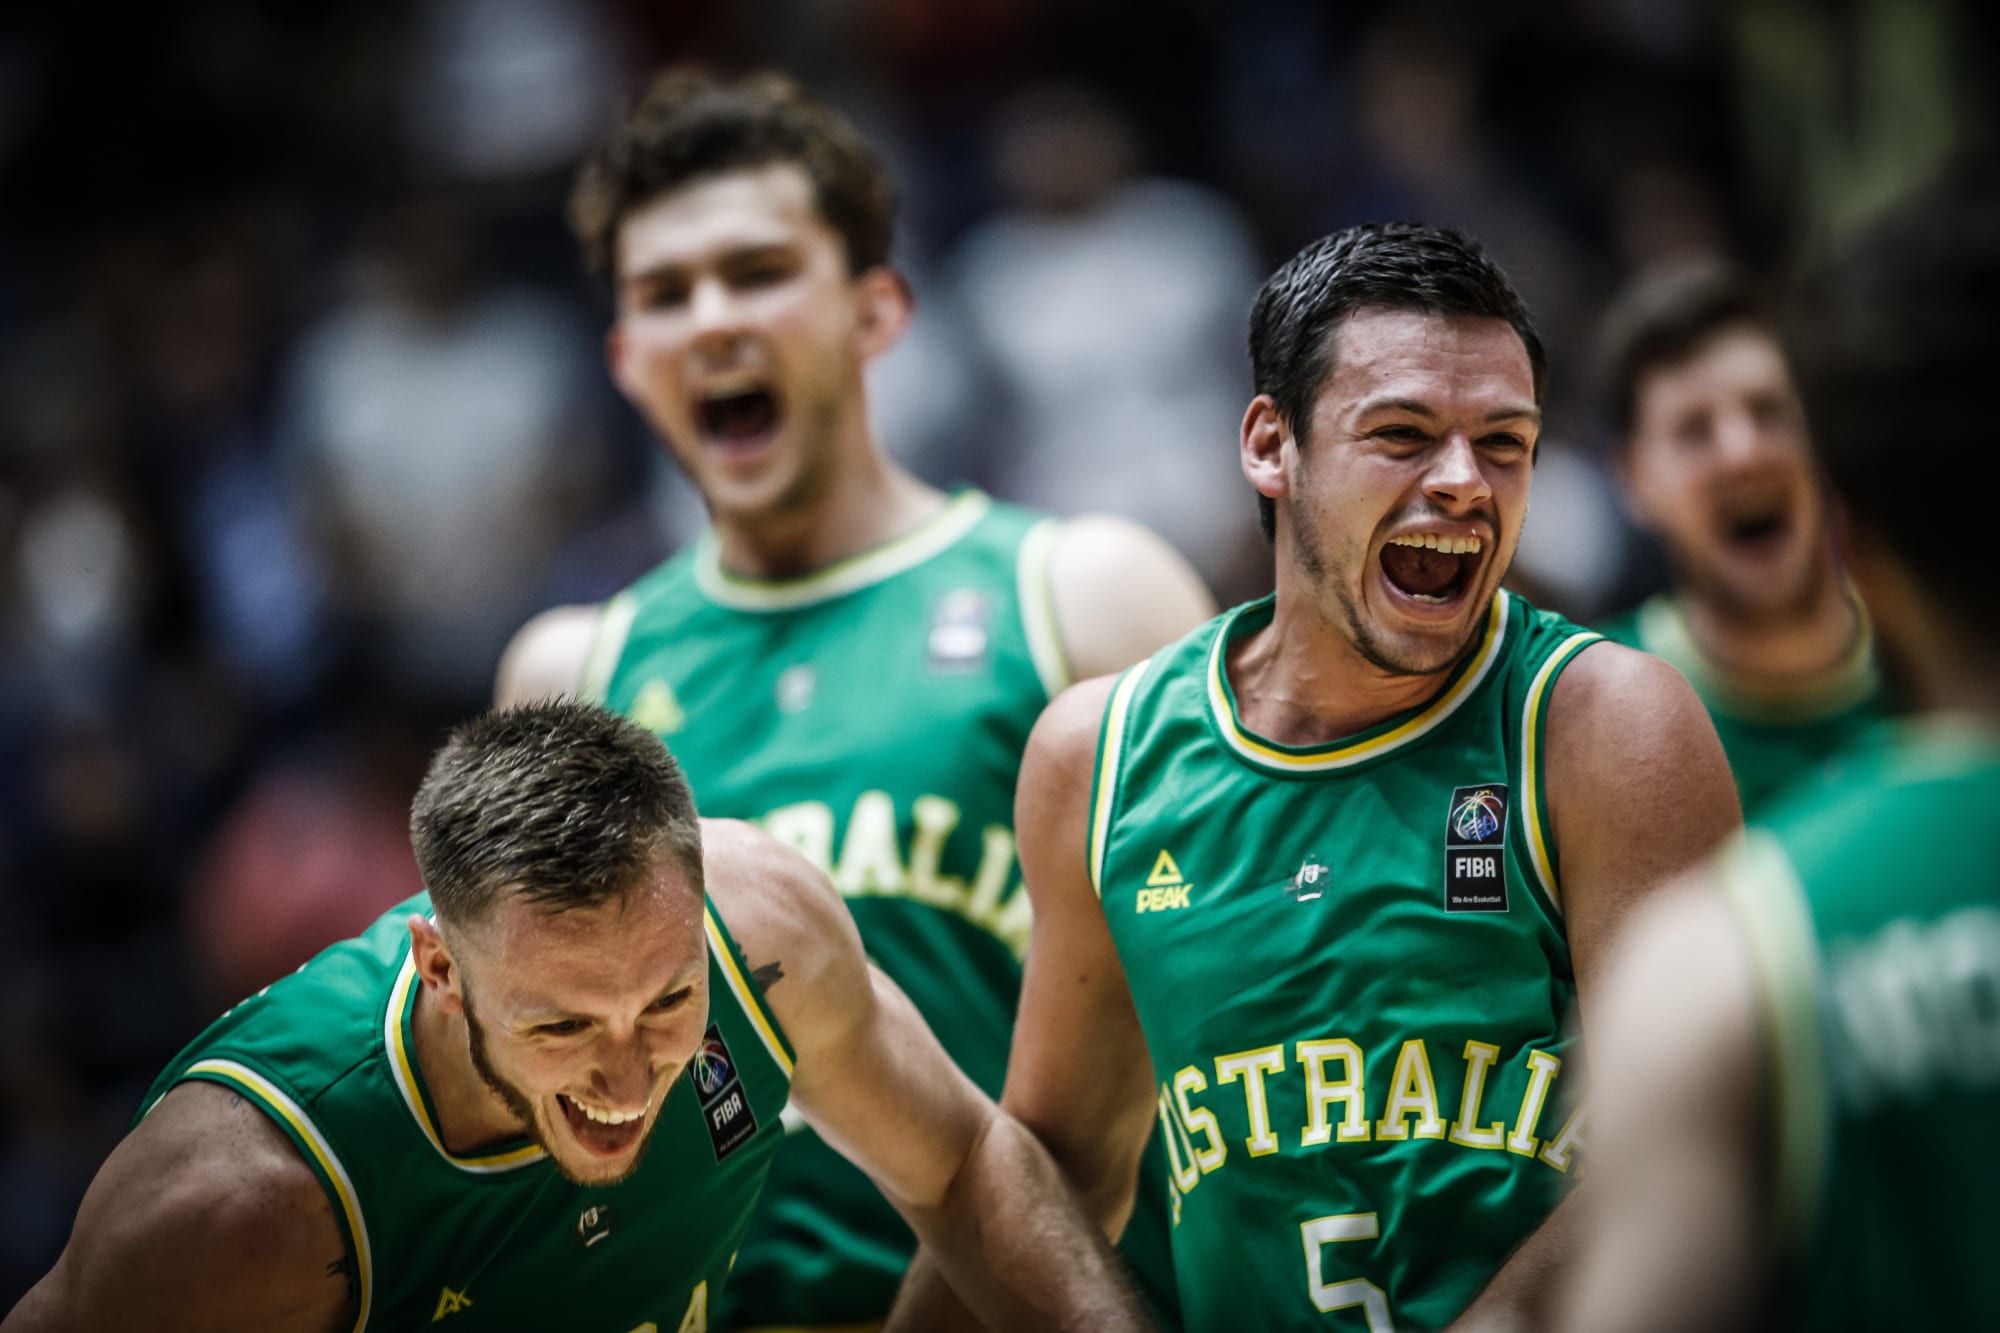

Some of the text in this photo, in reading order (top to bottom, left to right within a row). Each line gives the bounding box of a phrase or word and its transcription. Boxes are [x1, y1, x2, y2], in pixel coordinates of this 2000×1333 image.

[1456, 857, 1496, 878] FIBA
[1136, 883, 1194, 914] PEAK
[713, 1092, 742, 1130] FIBA
[1301, 1213, 1395, 1333] 5
